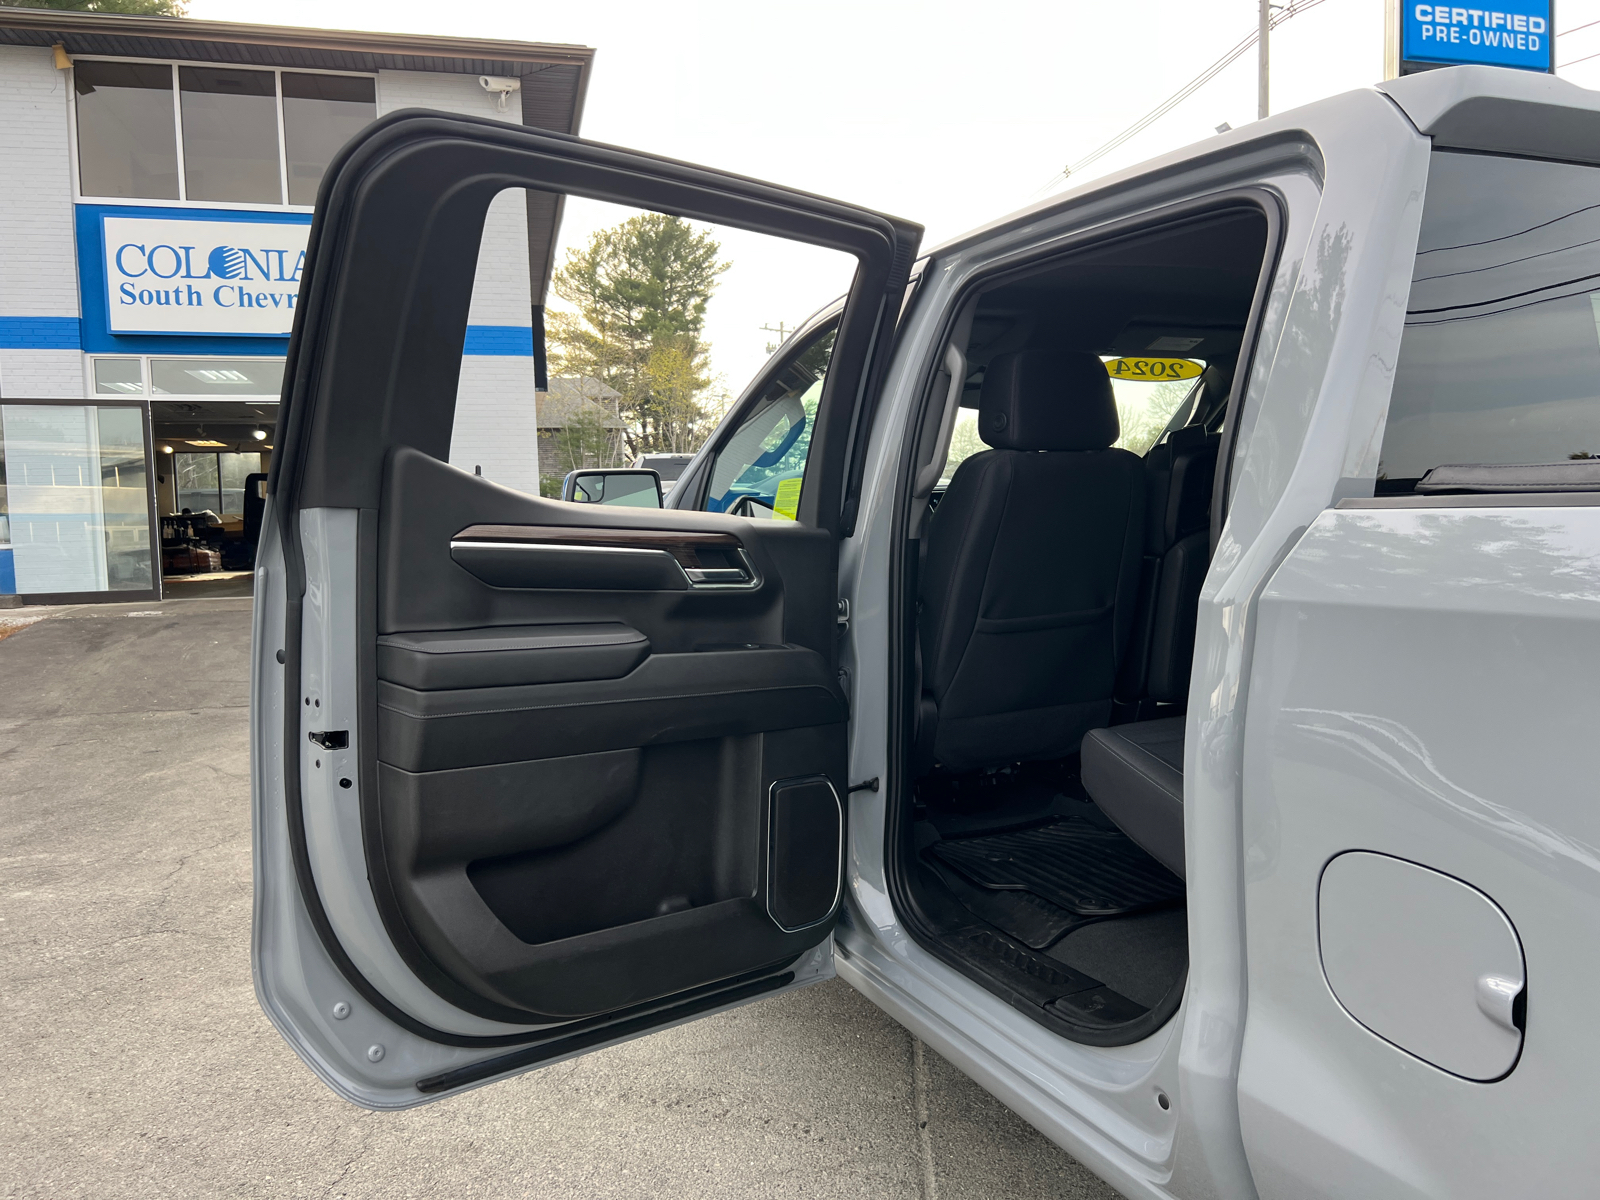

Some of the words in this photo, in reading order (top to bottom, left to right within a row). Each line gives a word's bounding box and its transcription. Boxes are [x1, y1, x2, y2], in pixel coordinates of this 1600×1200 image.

[1415, 4, 1546, 34] CERTIFIED
[1422, 24, 1540, 51] PRE-OWNED
[119, 282, 203, 307] South
